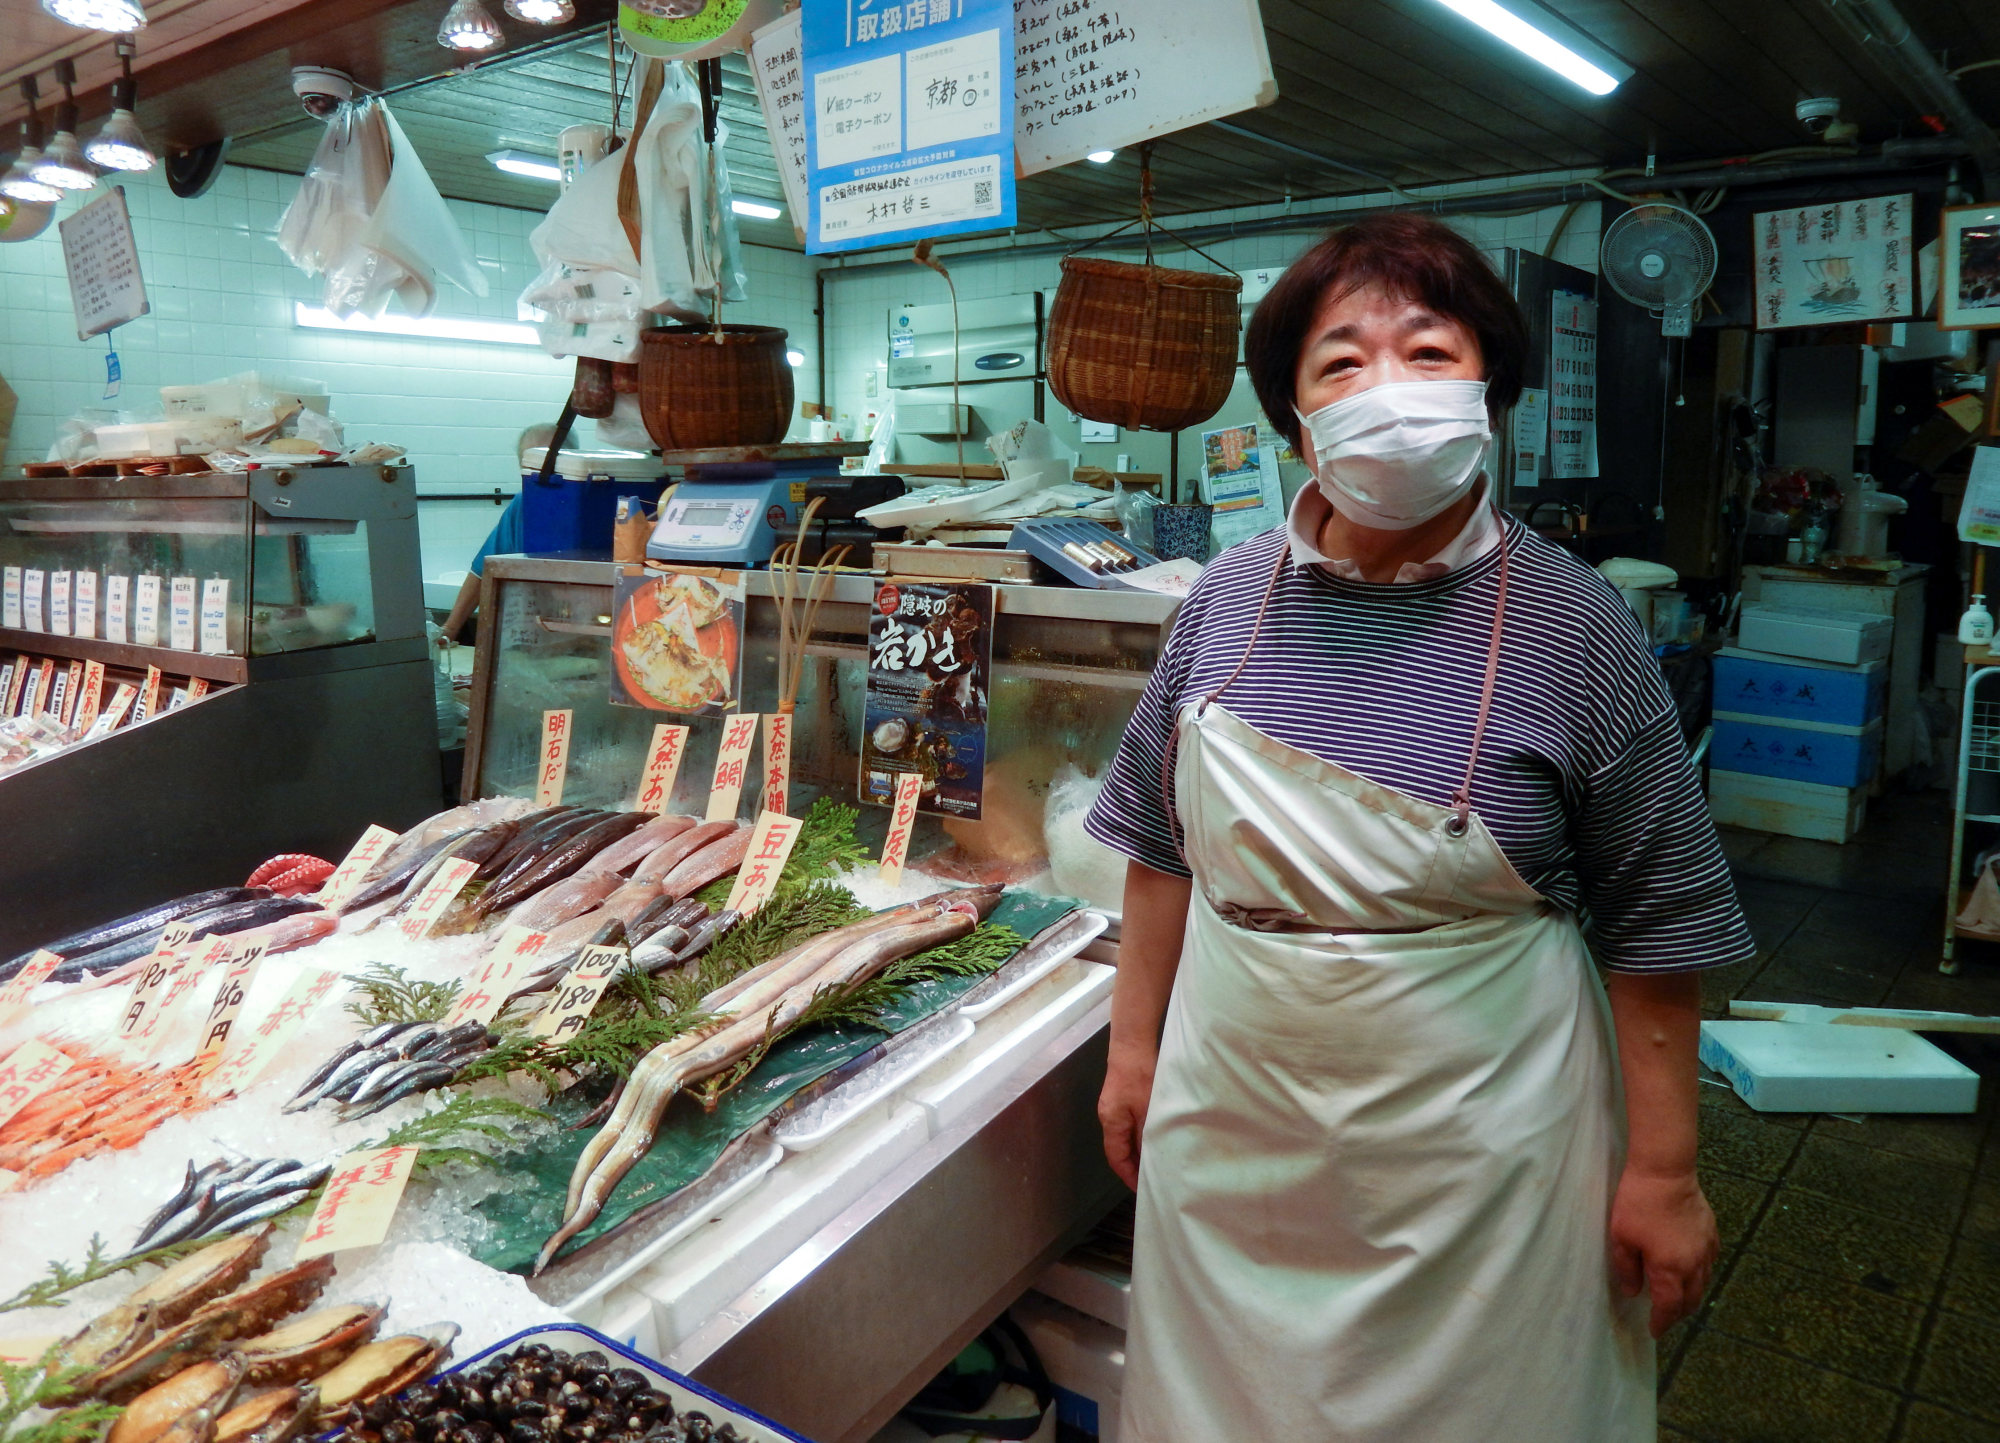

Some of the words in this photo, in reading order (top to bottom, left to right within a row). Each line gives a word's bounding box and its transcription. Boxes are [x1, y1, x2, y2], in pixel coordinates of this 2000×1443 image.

[856, 0, 951, 42] 取扱店舗
[835, 92, 882, 112] 紙クーポン
[925, 77, 958, 110] 京都
[836, 113, 893, 134] 電子クーポン
[900, 593, 948, 617] 隠岐の
[767, 716, 786, 816] 天然本鯛
[575, 948, 621, 978] 100g
[550, 985, 597, 1015] 180
